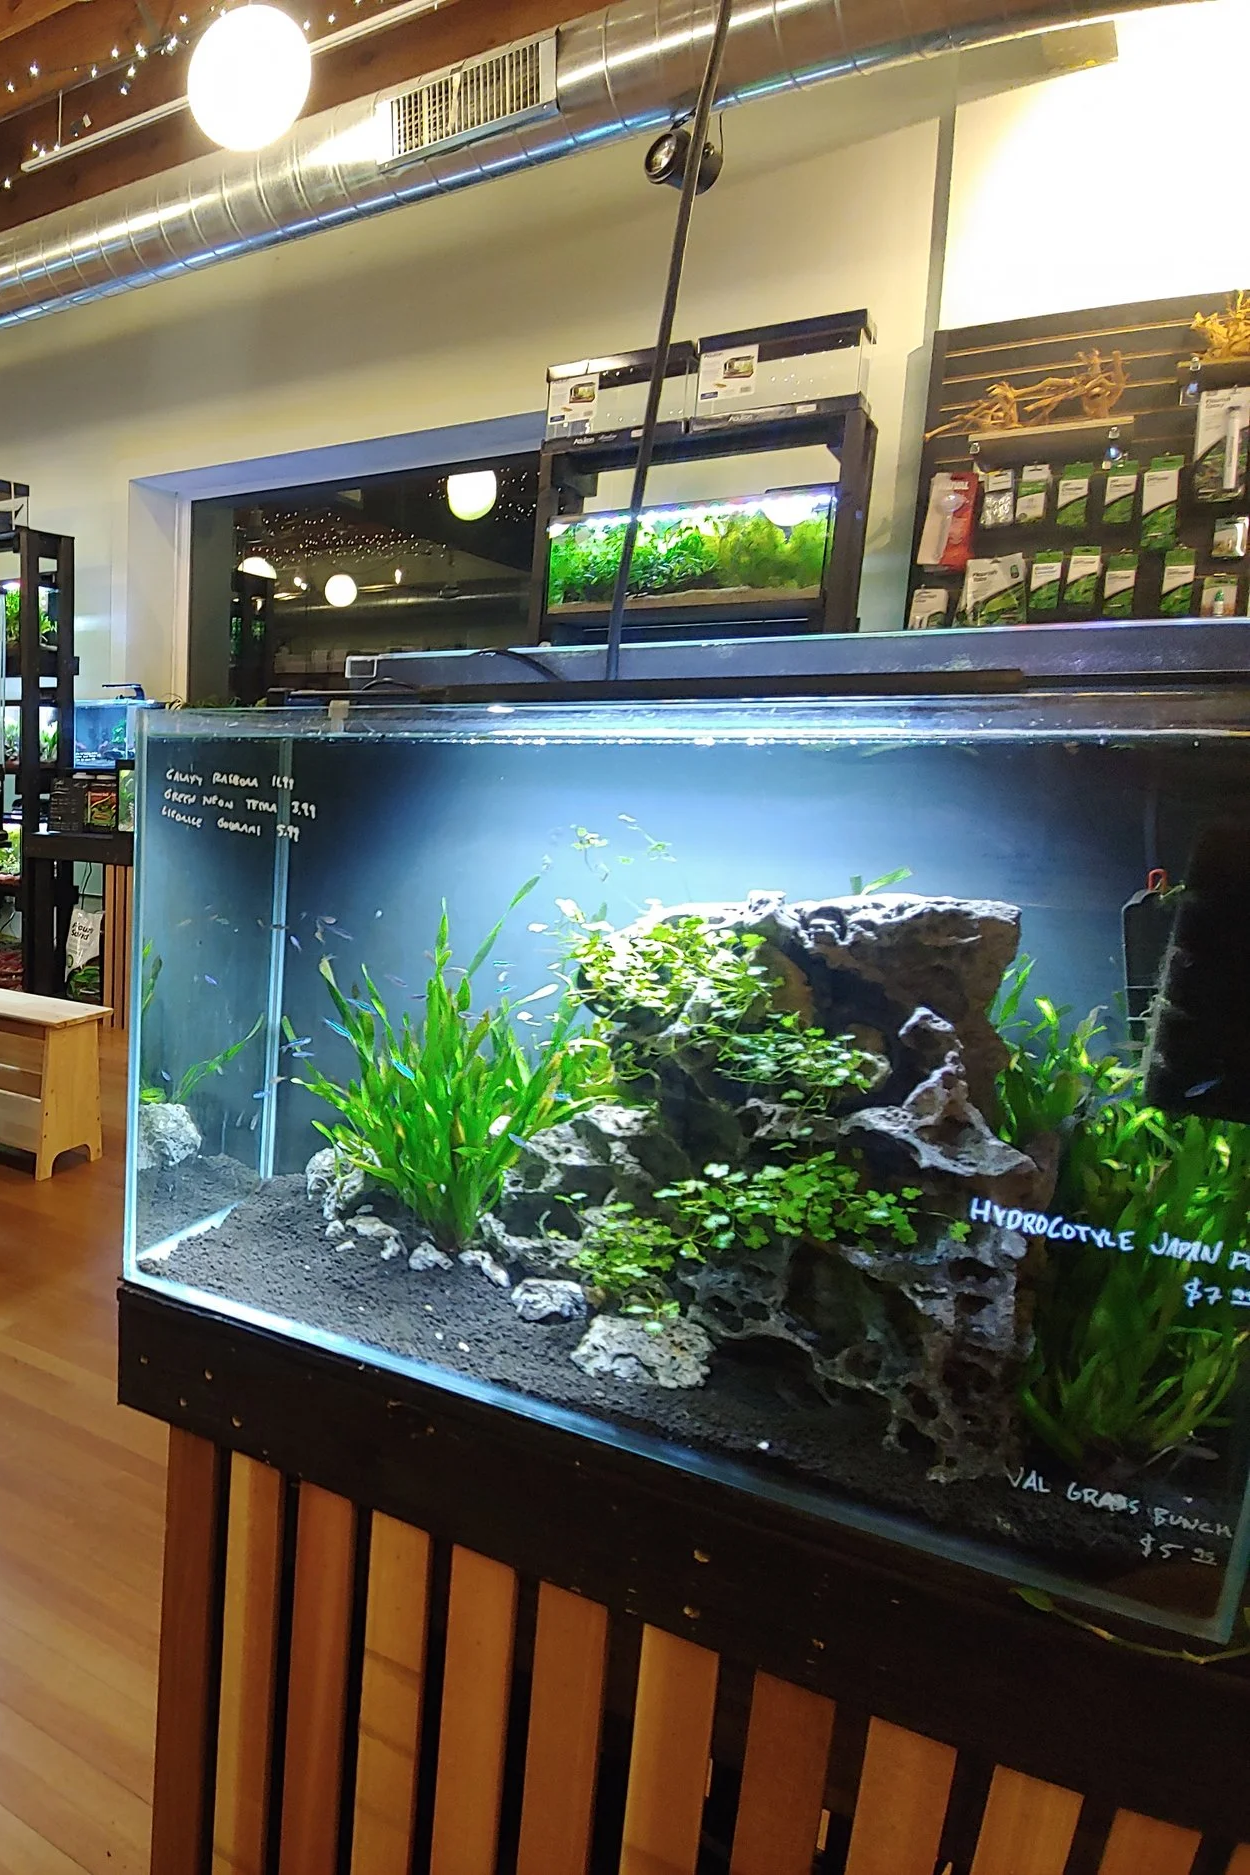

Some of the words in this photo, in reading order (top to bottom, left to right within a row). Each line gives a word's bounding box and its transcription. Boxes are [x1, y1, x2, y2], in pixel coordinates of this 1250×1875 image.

[202, 794, 234, 810] NEON
[291, 800, 316, 820] 3.99
[276, 823, 300, 843] 5.99
[970, 1197, 1136, 1252] HYDROCOTYLE
[1149, 1231, 1225, 1265] JAPAN
[1003, 1465, 1050, 1494] VAL
[1152, 1506, 1233, 1539] BUNCH
